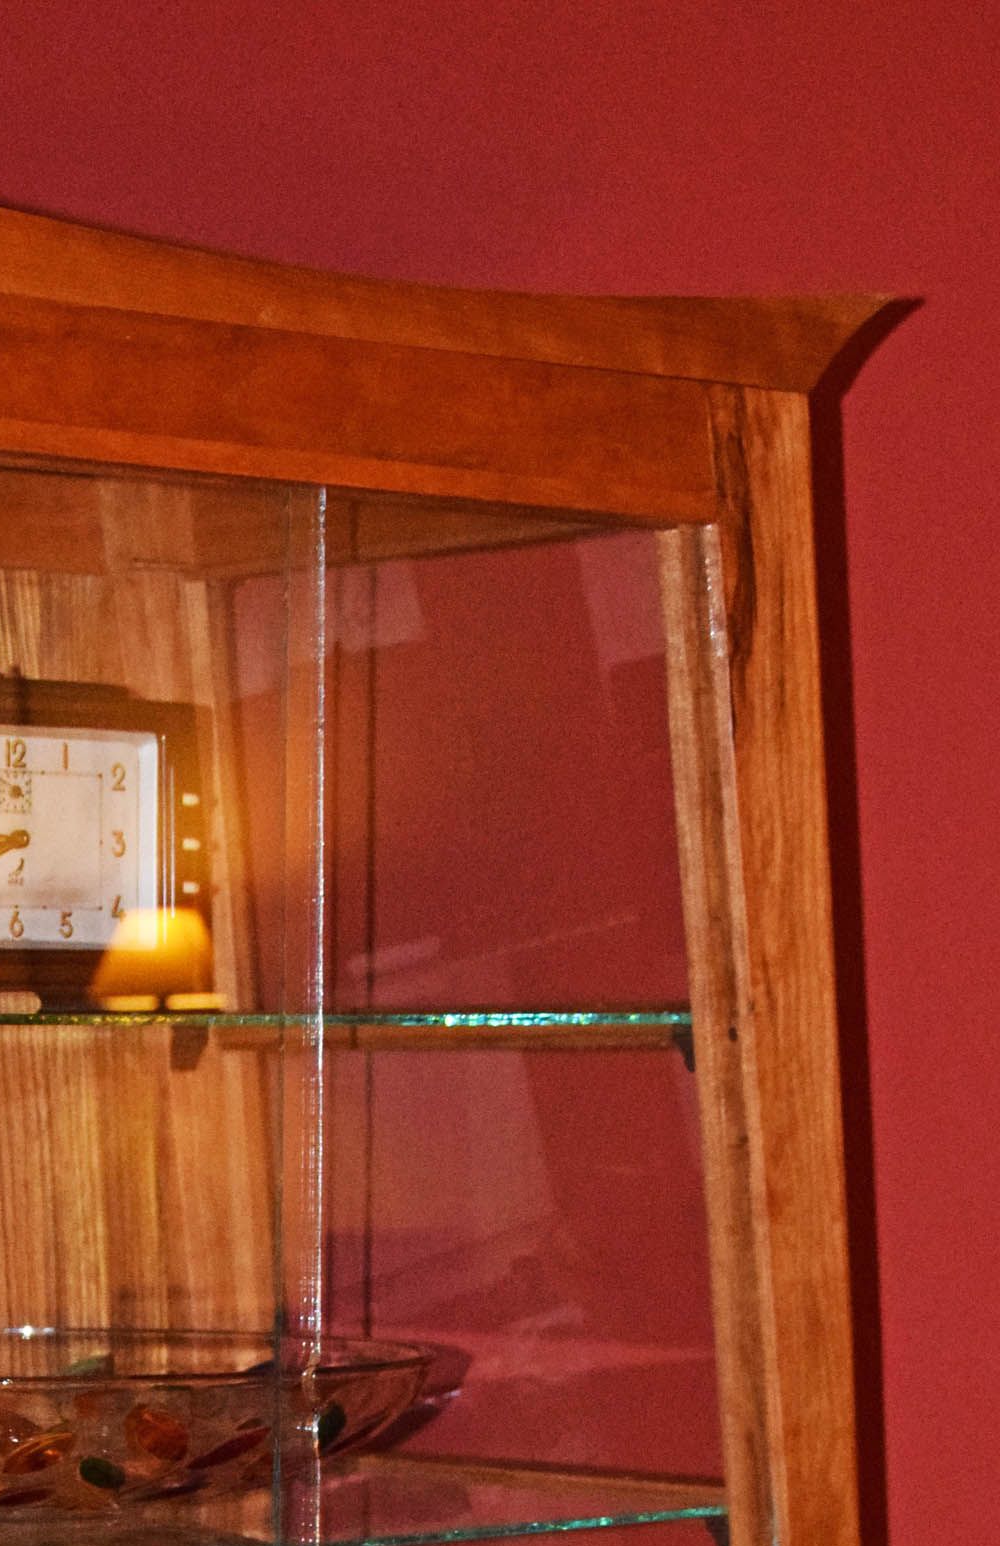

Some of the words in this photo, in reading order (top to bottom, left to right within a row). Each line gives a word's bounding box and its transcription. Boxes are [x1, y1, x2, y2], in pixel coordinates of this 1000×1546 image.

[5, 739, 27, 769] 12
[63, 742, 69, 770] 1
[111, 762, 126, 792] 2
[111, 830, 126, 858] 3
[111, 894, 126, 922] 4
[9, 909, 24, 938] 6
[60, 911, 74, 939] 5
